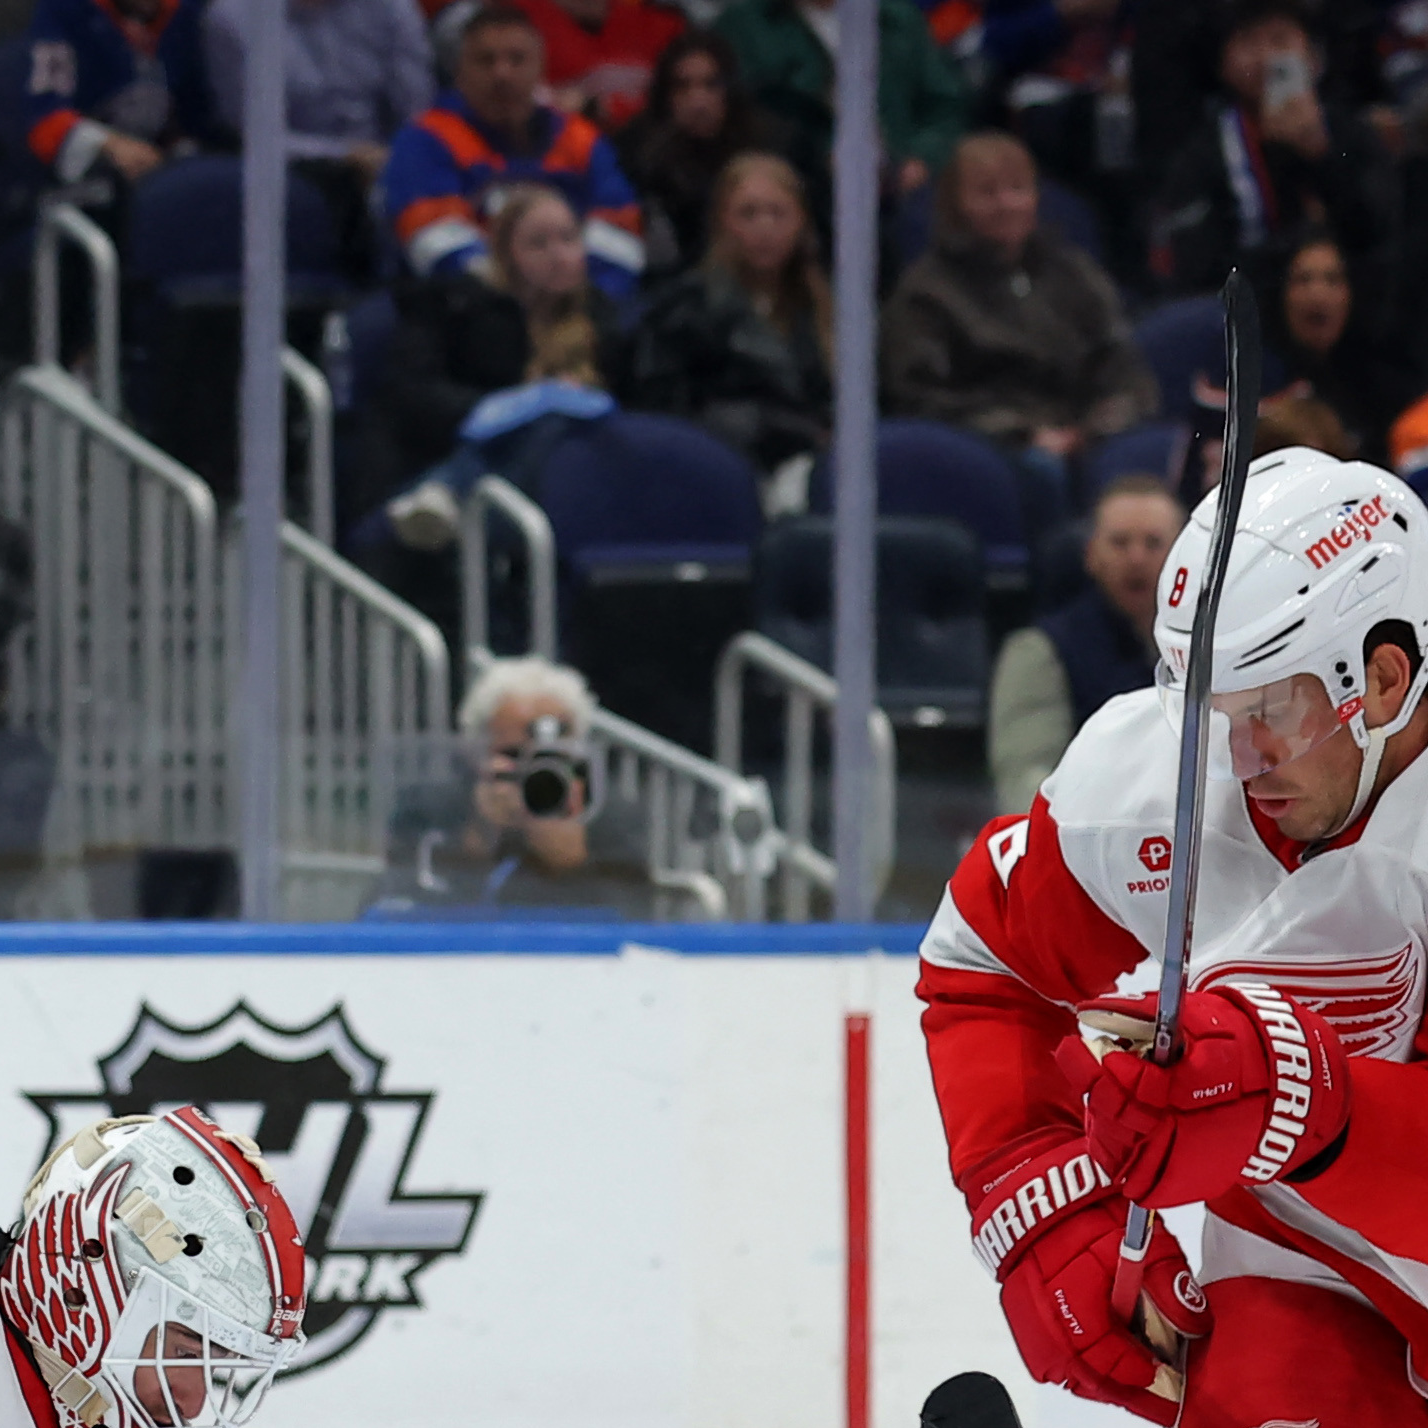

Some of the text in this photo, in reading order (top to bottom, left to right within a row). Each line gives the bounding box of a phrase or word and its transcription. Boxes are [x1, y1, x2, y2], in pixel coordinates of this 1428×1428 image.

[1305, 495, 1390, 569] meijer
[1168, 567, 1188, 608] 8
[1127, 877, 1170, 895] PRIO
[1225, 980, 1313, 1186] WARRIOR
